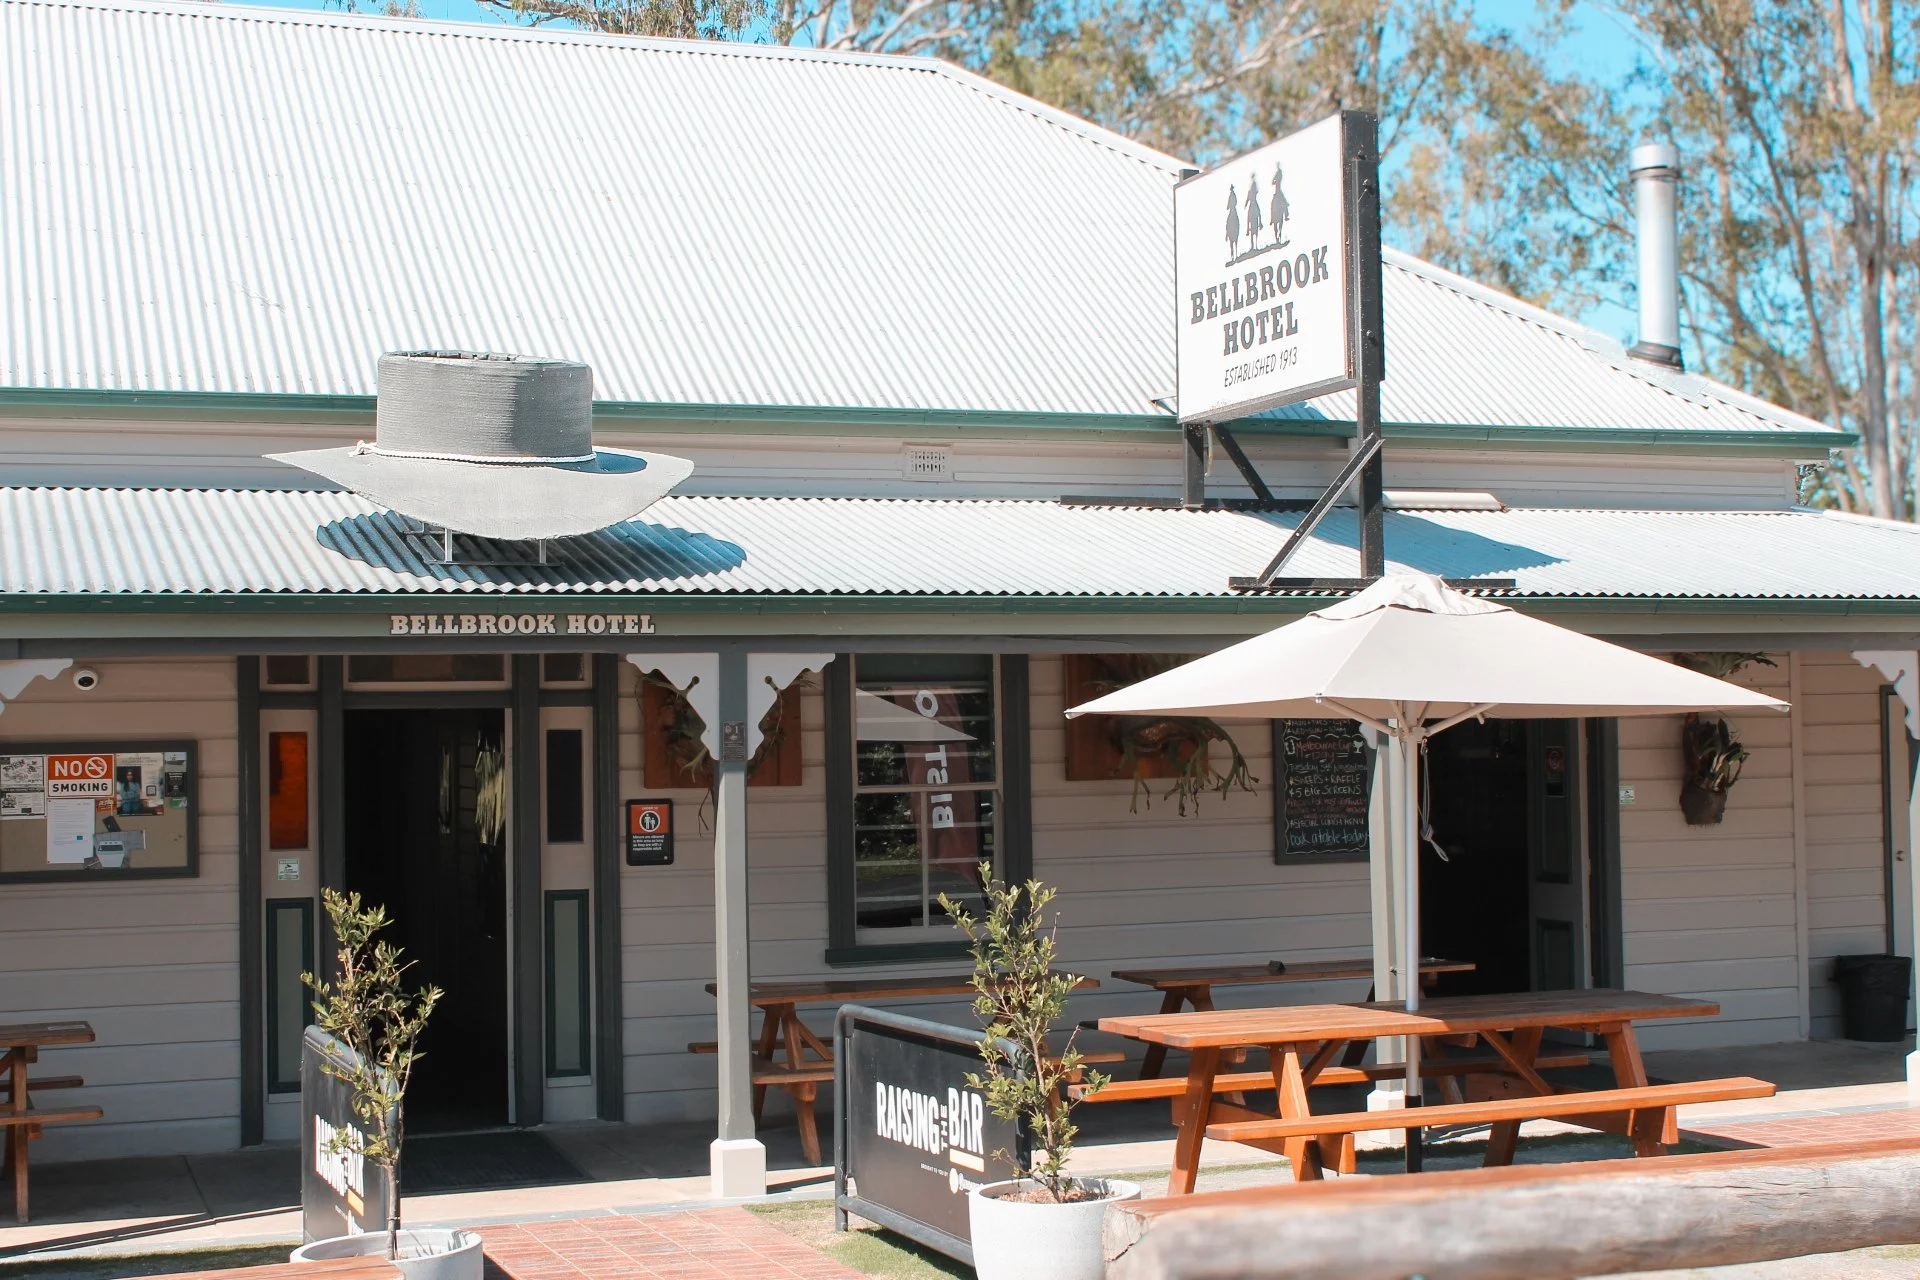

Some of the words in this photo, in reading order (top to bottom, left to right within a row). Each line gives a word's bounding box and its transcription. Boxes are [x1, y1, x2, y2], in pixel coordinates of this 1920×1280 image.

[1190, 245, 1329, 325] BELLBROOK
[1223, 301, 1298, 357] HOTEL
[1224, 354, 1277, 388] ESTABLISHED
[1278, 346, 1298, 370] 1913
[390, 614, 556, 634] BELLBROOK
[567, 614, 655, 634] HOTEL
[54, 760, 83, 777] NO
[52, 781, 108, 793] SMOKING
[1330, 773, 1361, 785] RAFFLE
[1304, 785, 1320, 797] BIG
[1321, 784, 1361, 796] SCREENS
[876, 1082, 940, 1155] RAISING
[940, 1103, 948, 1151] THE
[948, 1087, 984, 1155] BAR
